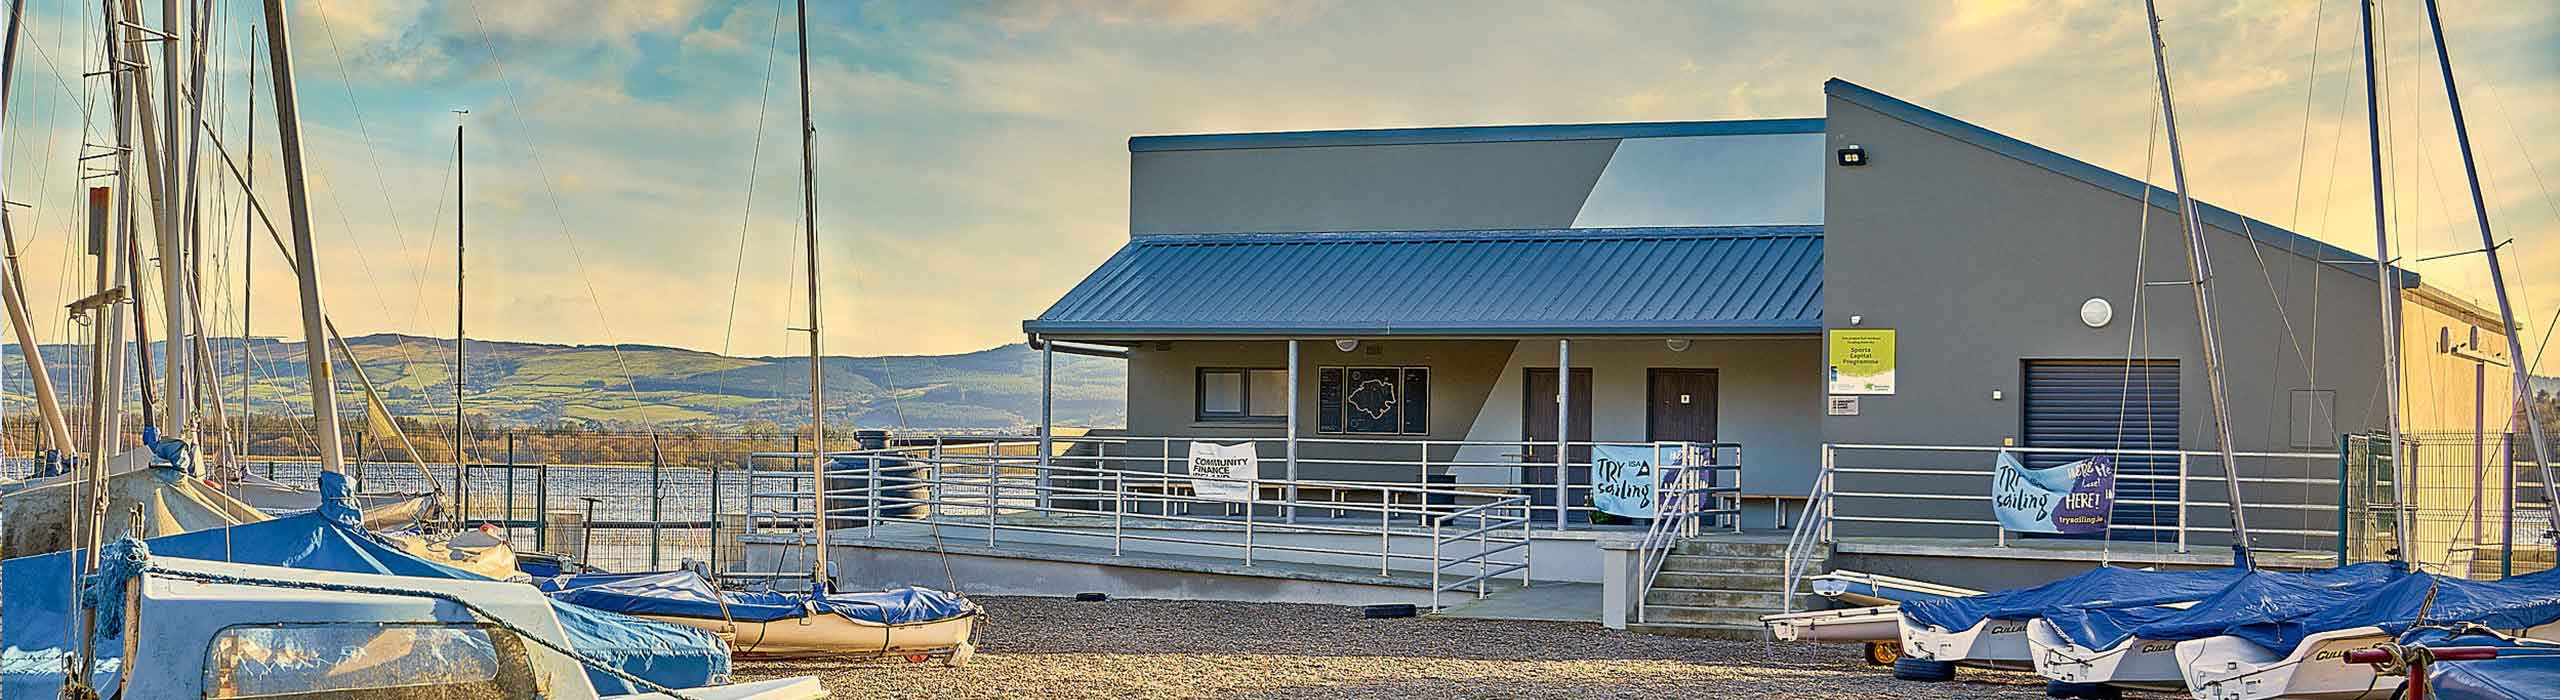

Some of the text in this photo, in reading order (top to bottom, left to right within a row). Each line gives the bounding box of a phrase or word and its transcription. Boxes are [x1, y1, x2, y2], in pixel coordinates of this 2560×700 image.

[1193, 465, 1230, 474] FINANCE
[1195, 457, 1248, 466] COMMUNITY
[1597, 458, 1626, 484] TRY
[1597, 479, 1651, 509] sailing
[2065, 493, 2100, 510] HERE!
[1997, 489, 2048, 521] sailing
